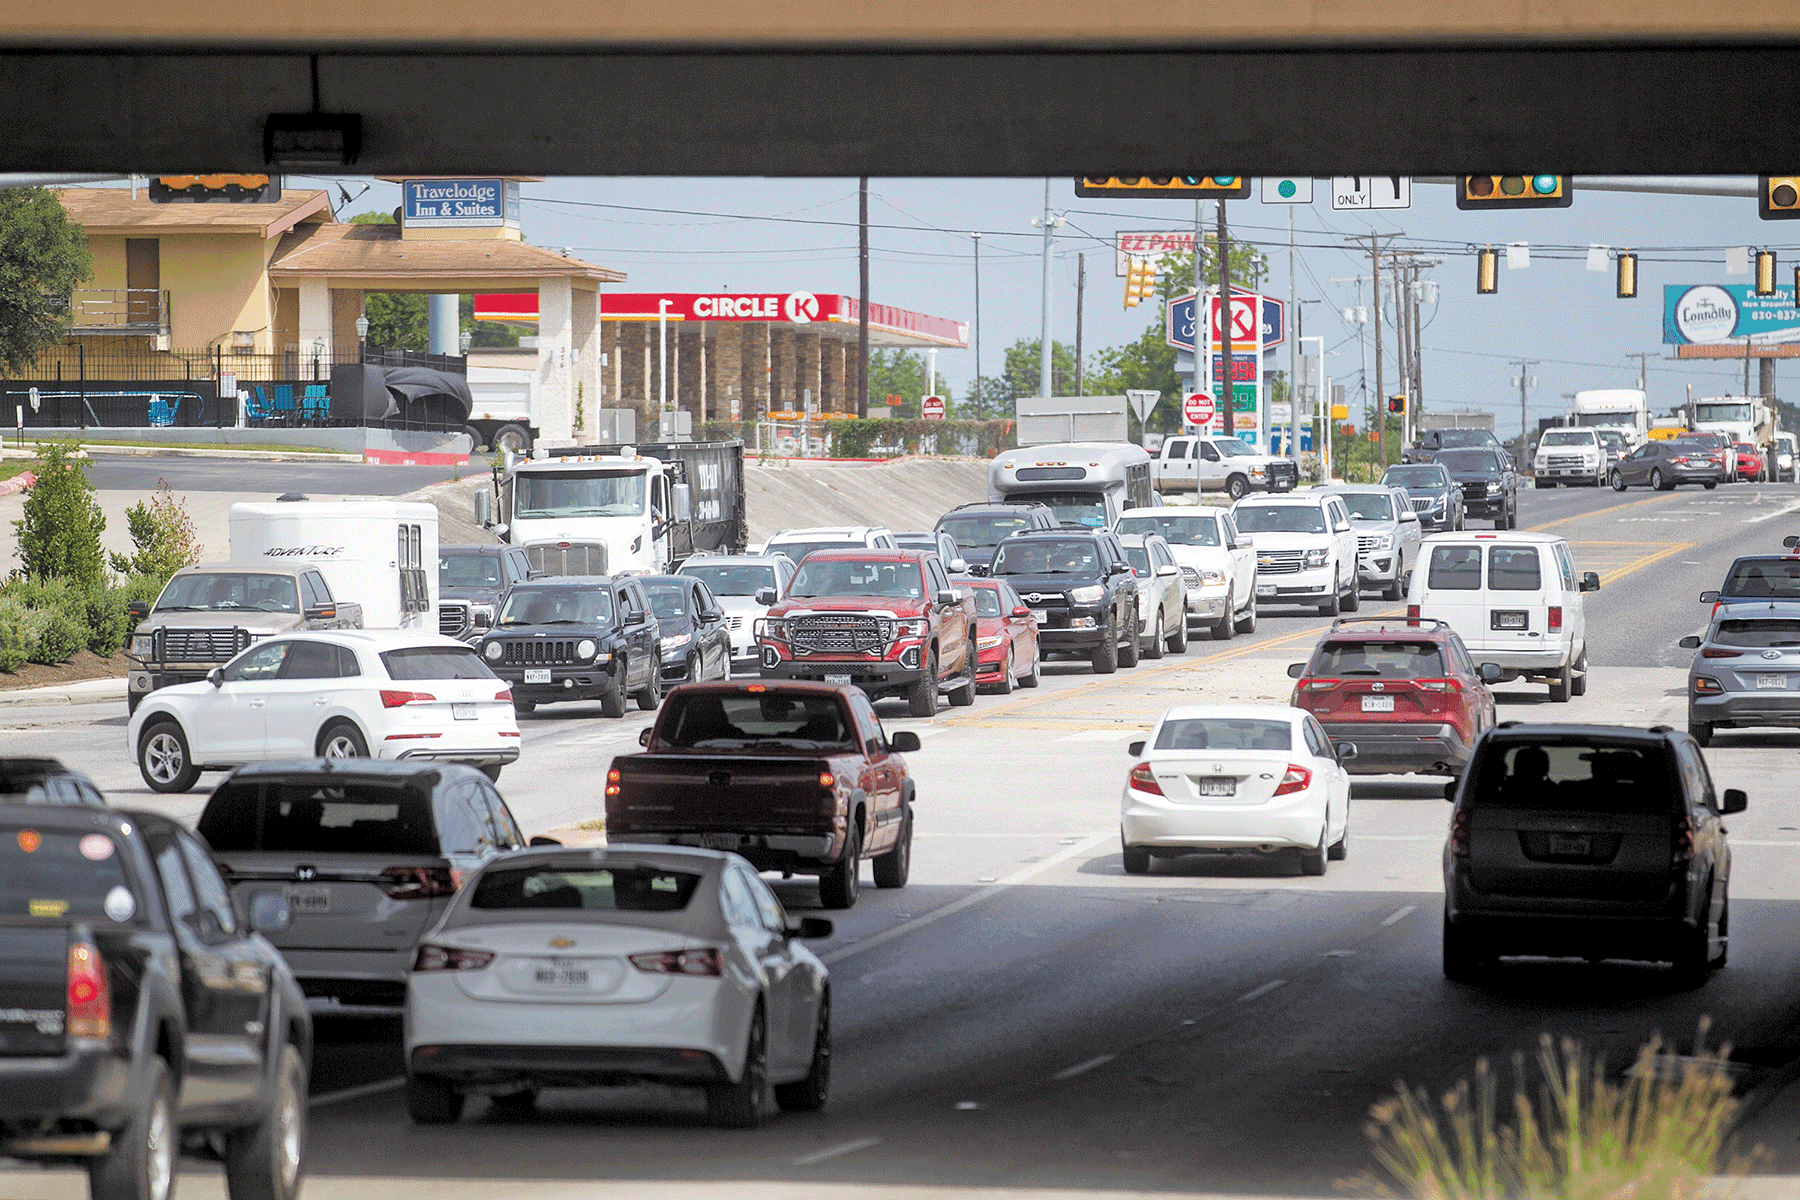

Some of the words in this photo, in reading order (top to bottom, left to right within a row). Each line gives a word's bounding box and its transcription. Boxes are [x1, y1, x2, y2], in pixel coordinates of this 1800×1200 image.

[412, 183, 495, 202] Travelodge
[1338, 194, 1366, 205] ONLY
[415, 202, 437, 217] Inn
[440, 202, 452, 216] &
[455, 201, 496, 216] Suites
[693, 297, 778, 317] CIRCLE
[1683, 307, 1732, 323] Connolly
[263, 545, 345, 556] ADVENTURE
